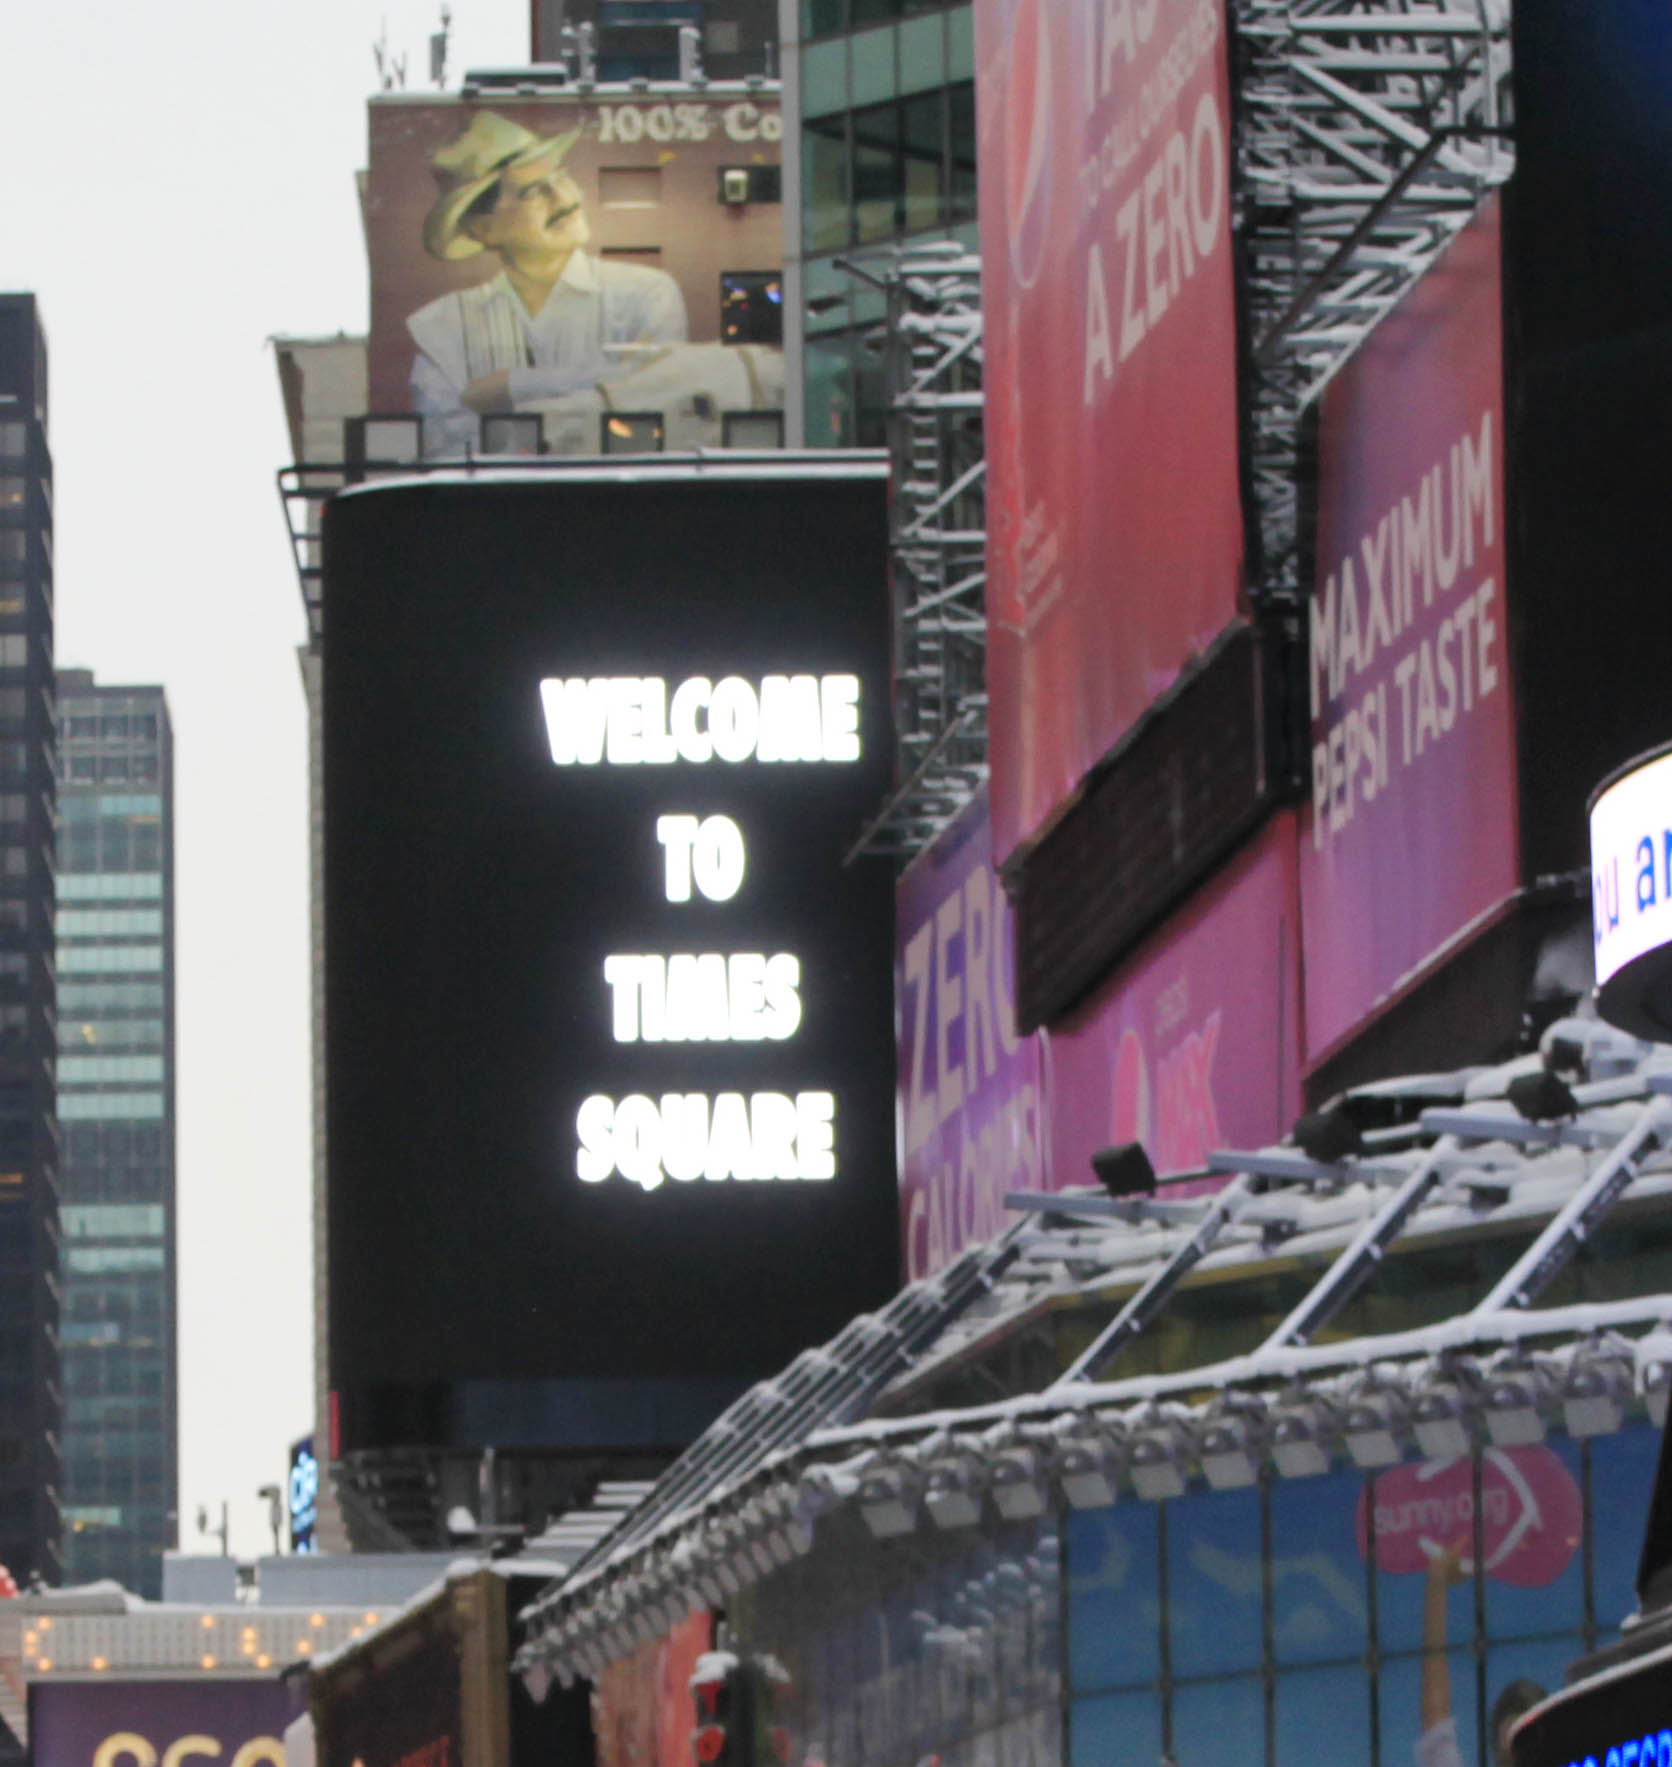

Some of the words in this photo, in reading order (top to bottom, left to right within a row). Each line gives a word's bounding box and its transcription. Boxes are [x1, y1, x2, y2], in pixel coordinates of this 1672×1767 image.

[597, 103, 710, 144] 100%
[723, 101, 784, 142] Co
[1083, 242, 1114, 405] A
[1115, 91, 1222, 363] ZERO
[1309, 409, 1494, 721] MAXIMUM
[539, 674, 861, 766] WELCOME
[1311, 682, 1389, 851] PEPSI
[1394, 576, 1497, 766] TASTE
[656, 813, 746, 903] TO
[604, 952, 803, 1043] TIMES
[575, 1090, 837, 1192] SQUARE
